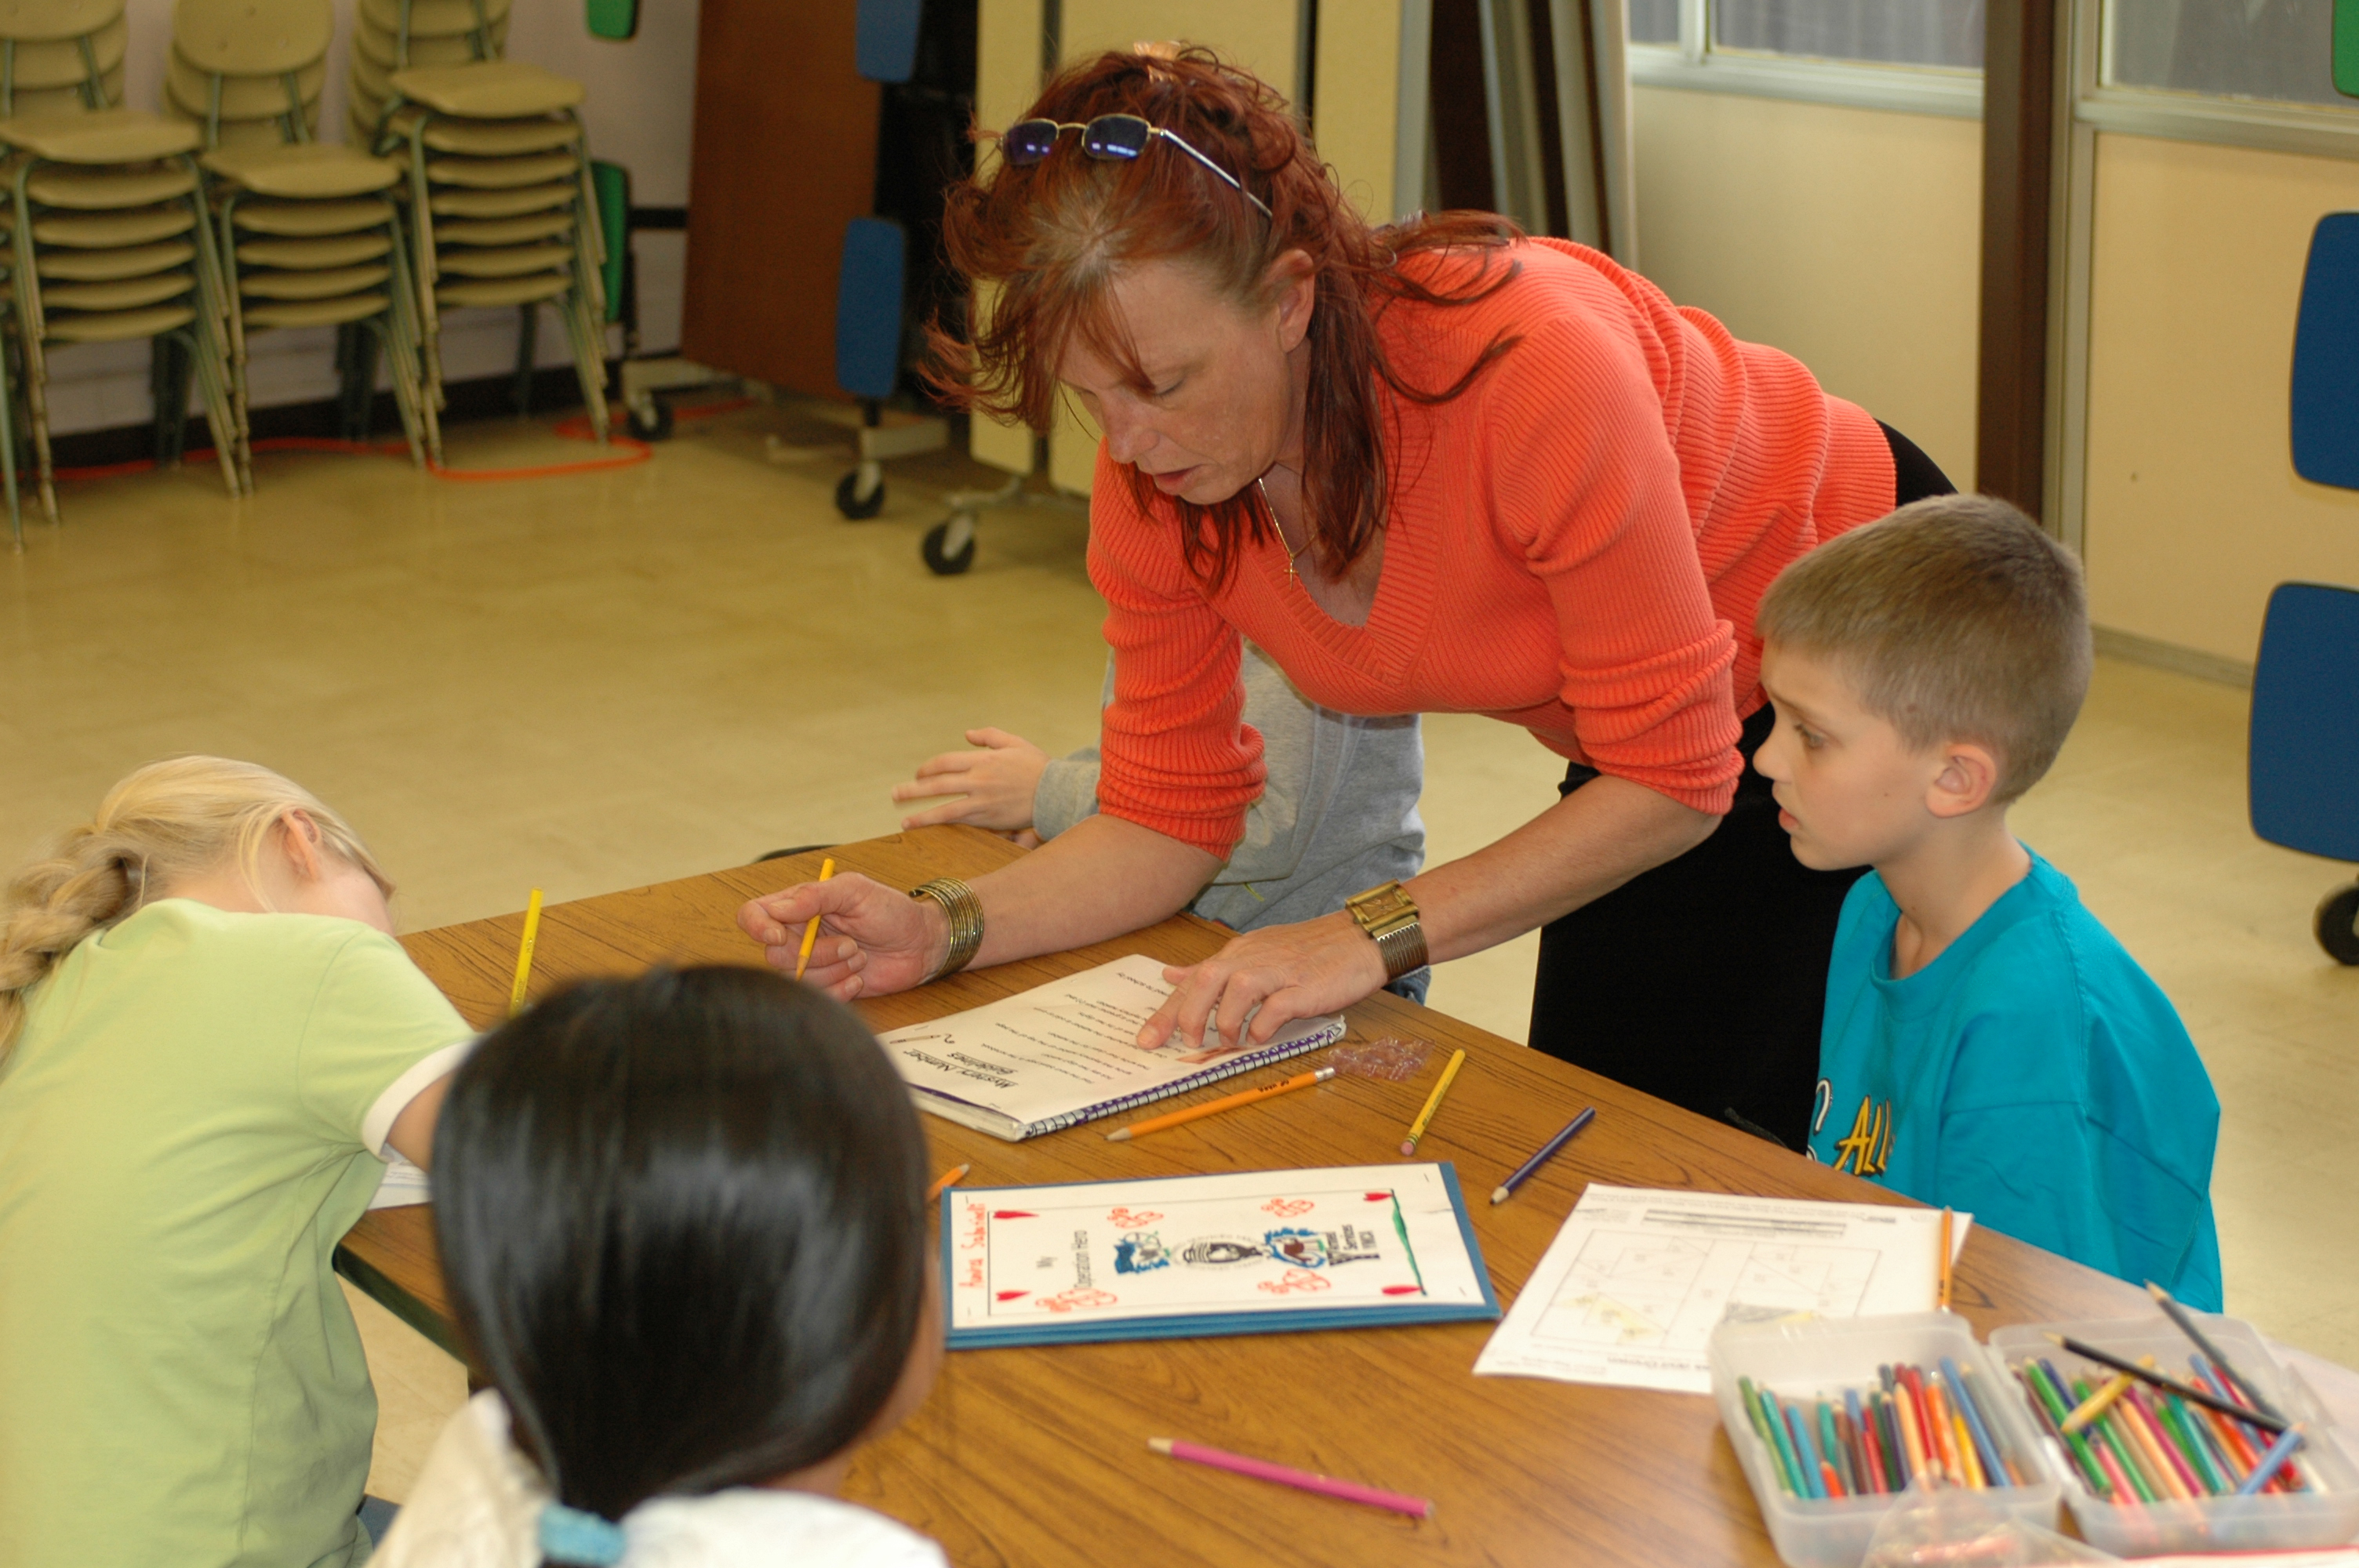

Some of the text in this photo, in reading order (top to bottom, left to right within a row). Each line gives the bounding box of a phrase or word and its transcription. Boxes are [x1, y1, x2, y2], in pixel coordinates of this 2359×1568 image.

[903, 1049, 1018, 1088] Mystery Number
[947, 1052, 1017, 1075] Guidelines
[1071, 1230, 1096, 1288] Operation Hero
